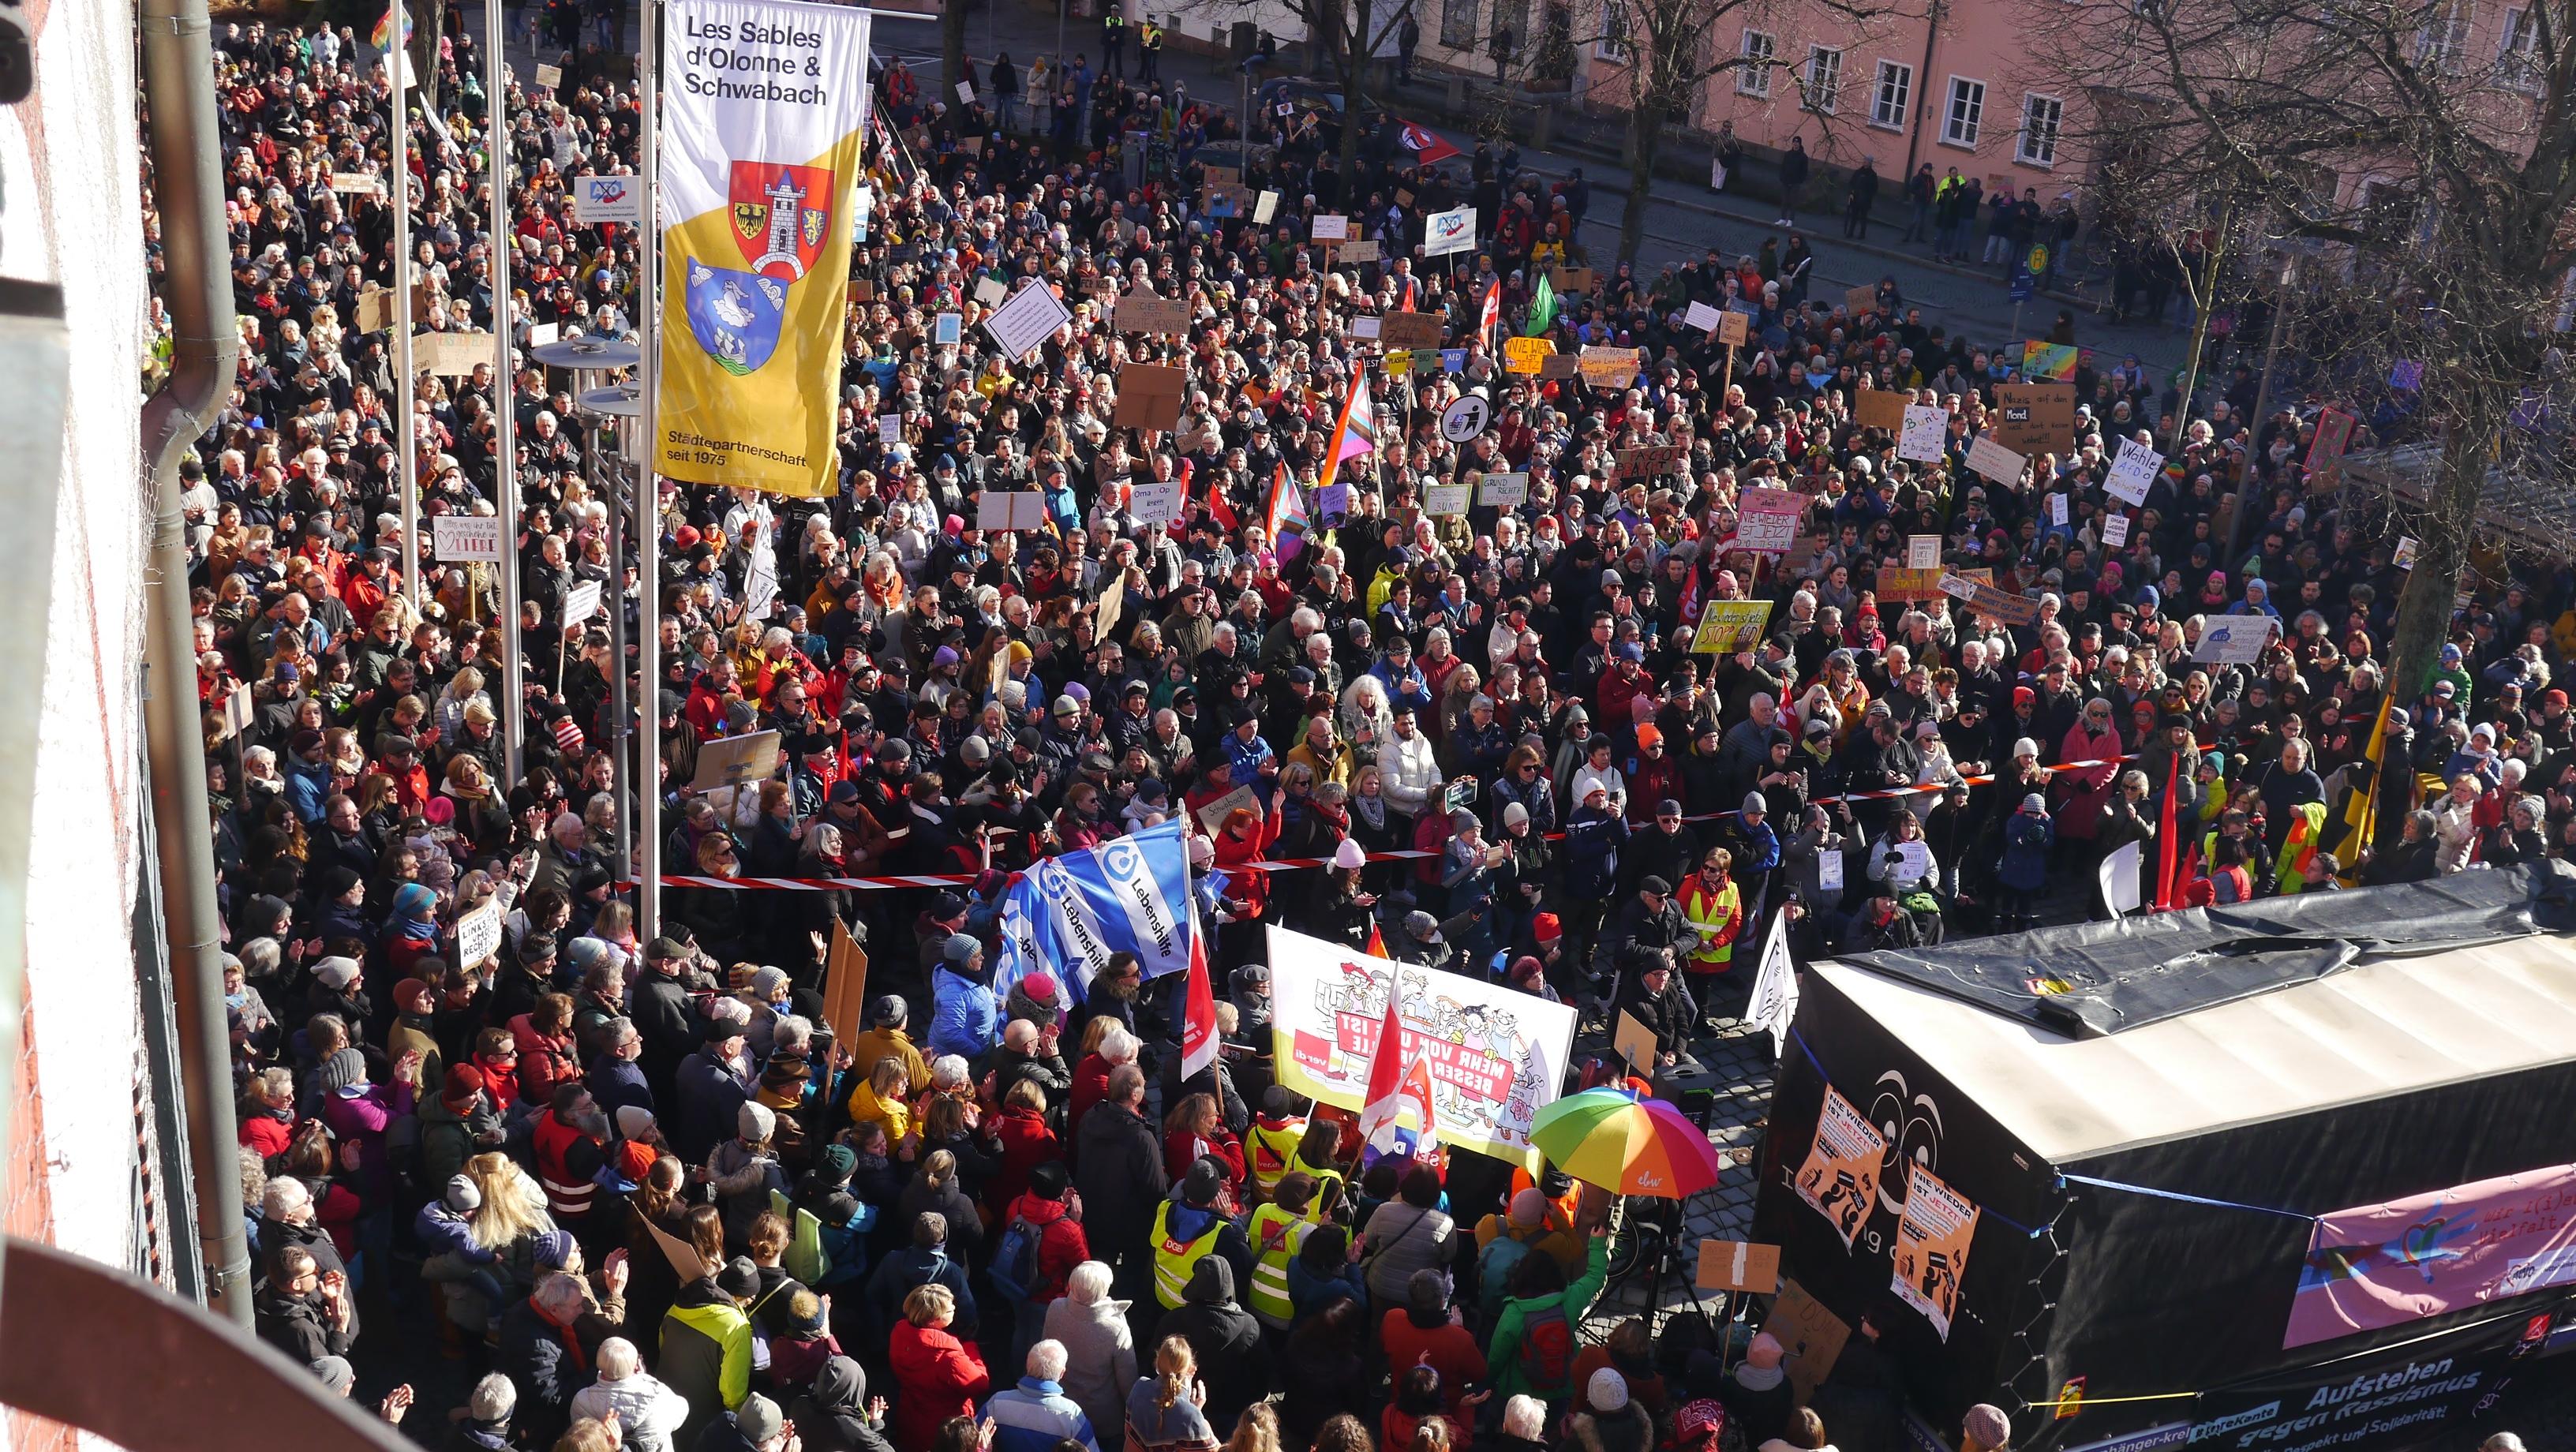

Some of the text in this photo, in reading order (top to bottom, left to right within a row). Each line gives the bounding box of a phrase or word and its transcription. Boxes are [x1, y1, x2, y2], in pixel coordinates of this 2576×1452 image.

[687, 15, 822, 49] Les Sables
[804, 58, 822, 77] &
[685, 73, 827, 106] Schwabach
[2034, 251, 2046, 269] H
[1508, 339, 1527, 354] NIE
[1365, 358, 1380, 369] EST
[1418, 354, 1430, 362] BIO
[1446, 353, 1461, 362] AfD
[2003, 391, 2030, 404] Nazis
[1905, 410, 1939, 430] Bunt
[2006, 409, 2027, 420] Mond
[668, 430, 807, 467] Städtepartnerschaft
[1911, 442, 1934, 454] braun
[667, 450, 725, 466] seit 1975
[2117, 461, 2140, 477] AfD
[1484, 478, 1509, 488] GRUND
[1497, 485, 1522, 495] RECHTE
[1133, 489, 1151, 498] Oma
[1484, 494, 1523, 503] verteidigen
[1146, 499, 1164, 507] gegen
[1141, 505, 1170, 519] rechts!
[1742, 511, 1789, 526] NIE WIEDER
[1739, 525, 1793, 539] IST JETZT
[2105, 530, 2125, 538] RECHTS
[455, 538, 496, 552] LIEBE
[1893, 579, 1923, 591] STATT
[1707, 607, 1718, 623] Nie
[1718, 610, 1738, 623] wieder
[1701, 625, 1735, 644] STOPP
[1130, 878, 1170, 957] Lebenshilfe
[1827, 1104, 1841, 1121] IST
[1840, 1120, 1870, 1147] JETZT!
[1829, 1093, 1847, 1110] NIE
[1846, 1110, 1881, 1148] WIEDER
[1913, 1183, 1929, 1198] IST
[1929, 1196, 1962, 1223] JETZT!
[1915, 1171, 1933, 1188] NIE
[1934, 1186, 1972, 1220] WIEDER
[2482, 1207, 2514, 1223] Wir
[1166, 1239, 1183, 1254] DGB
[2304, 1357, 2454, 1411] Aufstehen
[2237, 1371, 2483, 1449] gegen Rassismus
[2342, 1405, 2449, 1444] und Solidarität!
